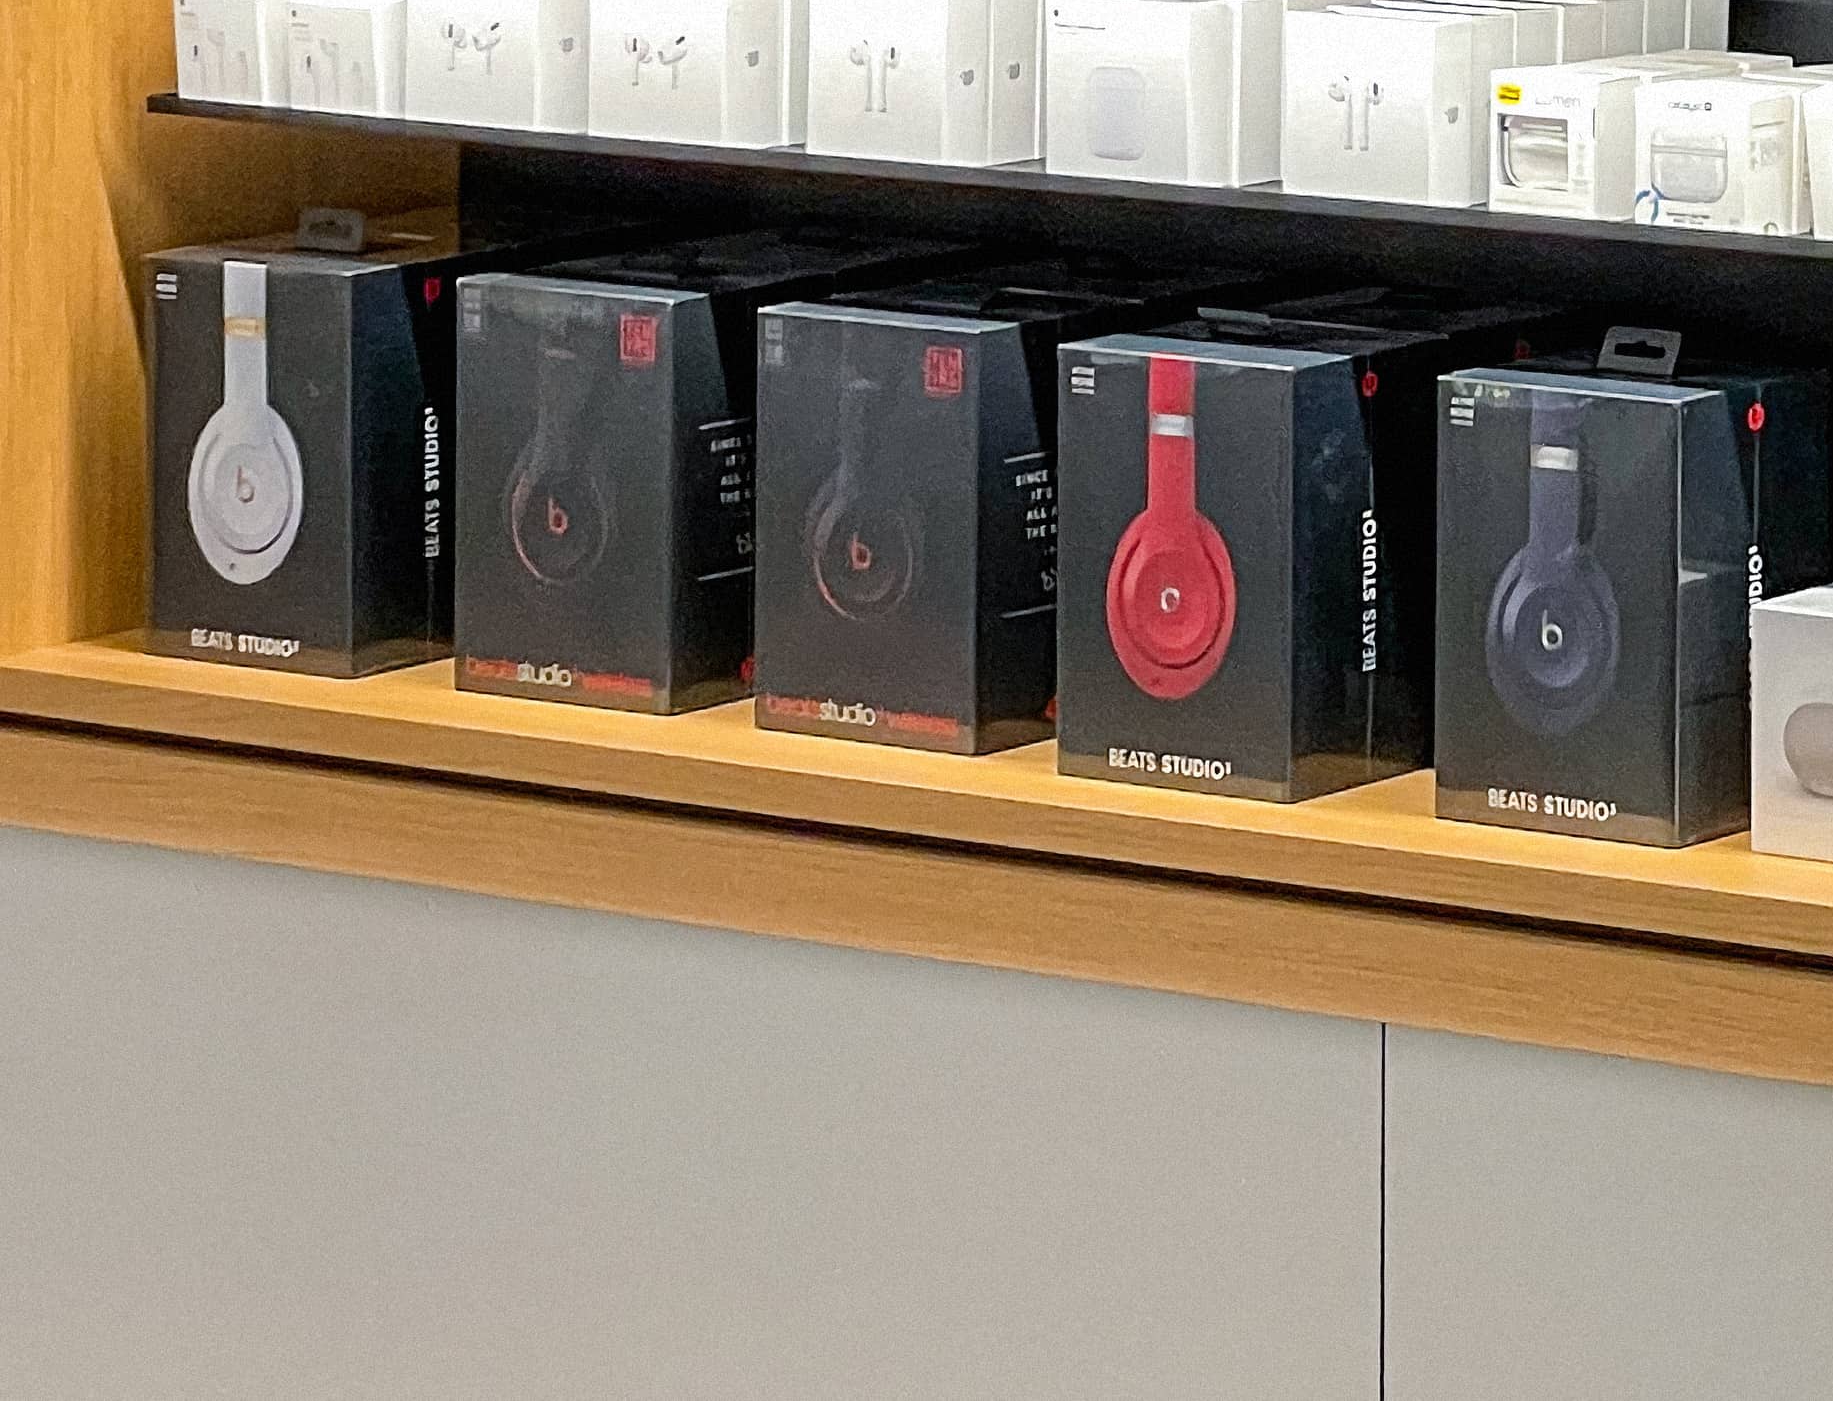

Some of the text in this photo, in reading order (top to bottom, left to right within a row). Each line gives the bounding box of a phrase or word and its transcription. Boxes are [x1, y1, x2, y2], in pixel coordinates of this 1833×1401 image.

[424, 498, 440, 558] BEATS
[1362, 608, 1377, 672] BEATS
[1108, 747, 1157, 772] BEATS
[1487, 787, 1538, 813] BEATS
